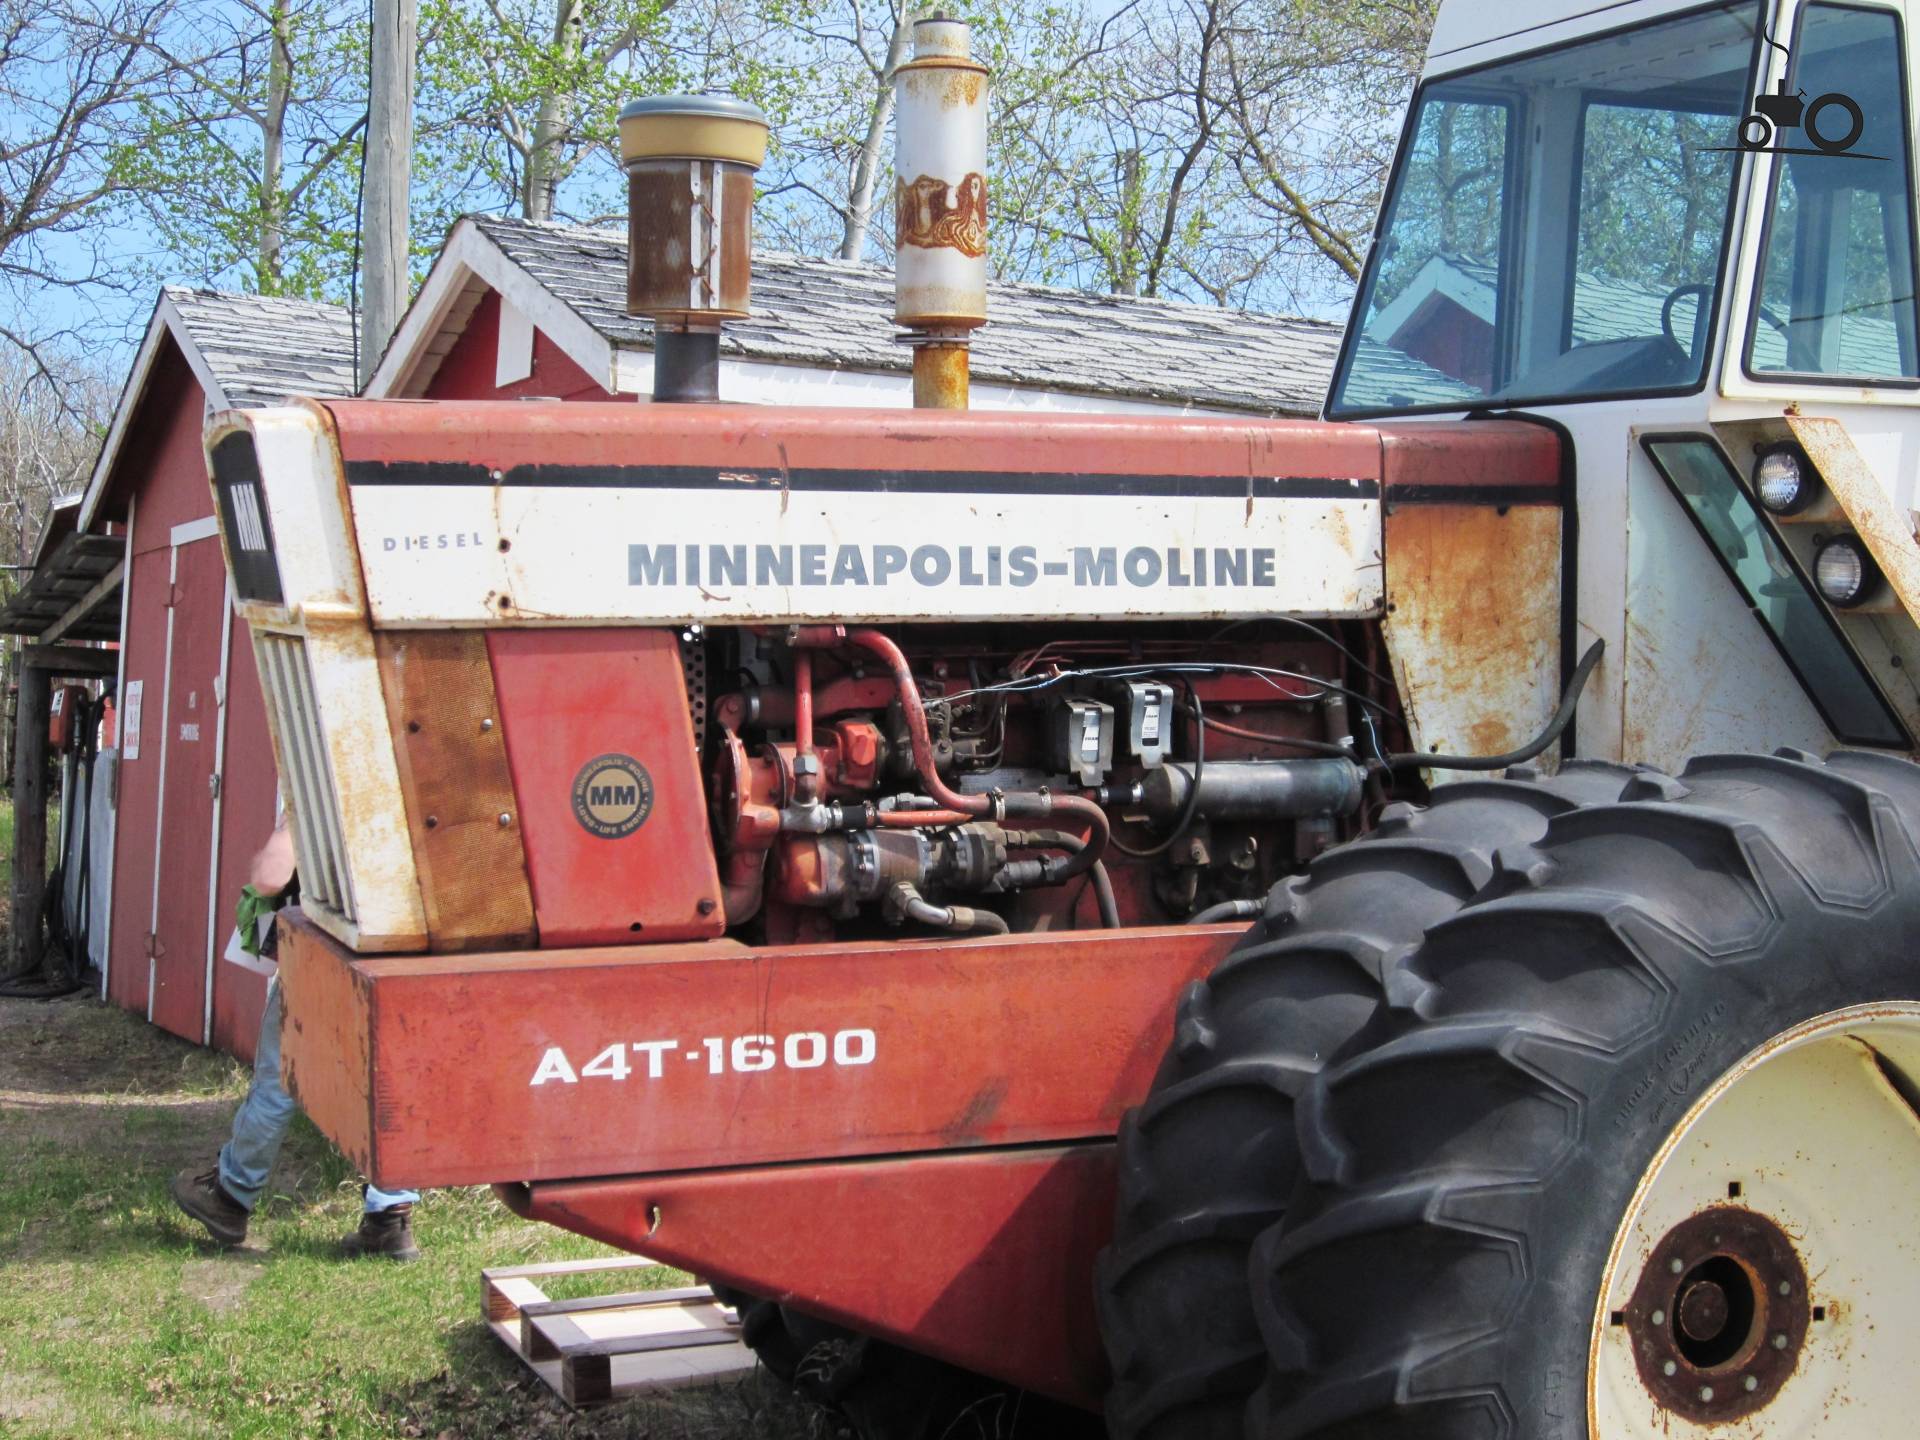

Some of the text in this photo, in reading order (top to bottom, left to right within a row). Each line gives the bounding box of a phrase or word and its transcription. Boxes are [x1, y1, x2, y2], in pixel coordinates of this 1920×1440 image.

[383, 532, 483, 552] DIESEL
[627, 544, 1276, 587] MINNEAPOLIS-MOLINE
[590, 785, 636, 806] MM
[529, 1028, 876, 1086] A4T-1600
